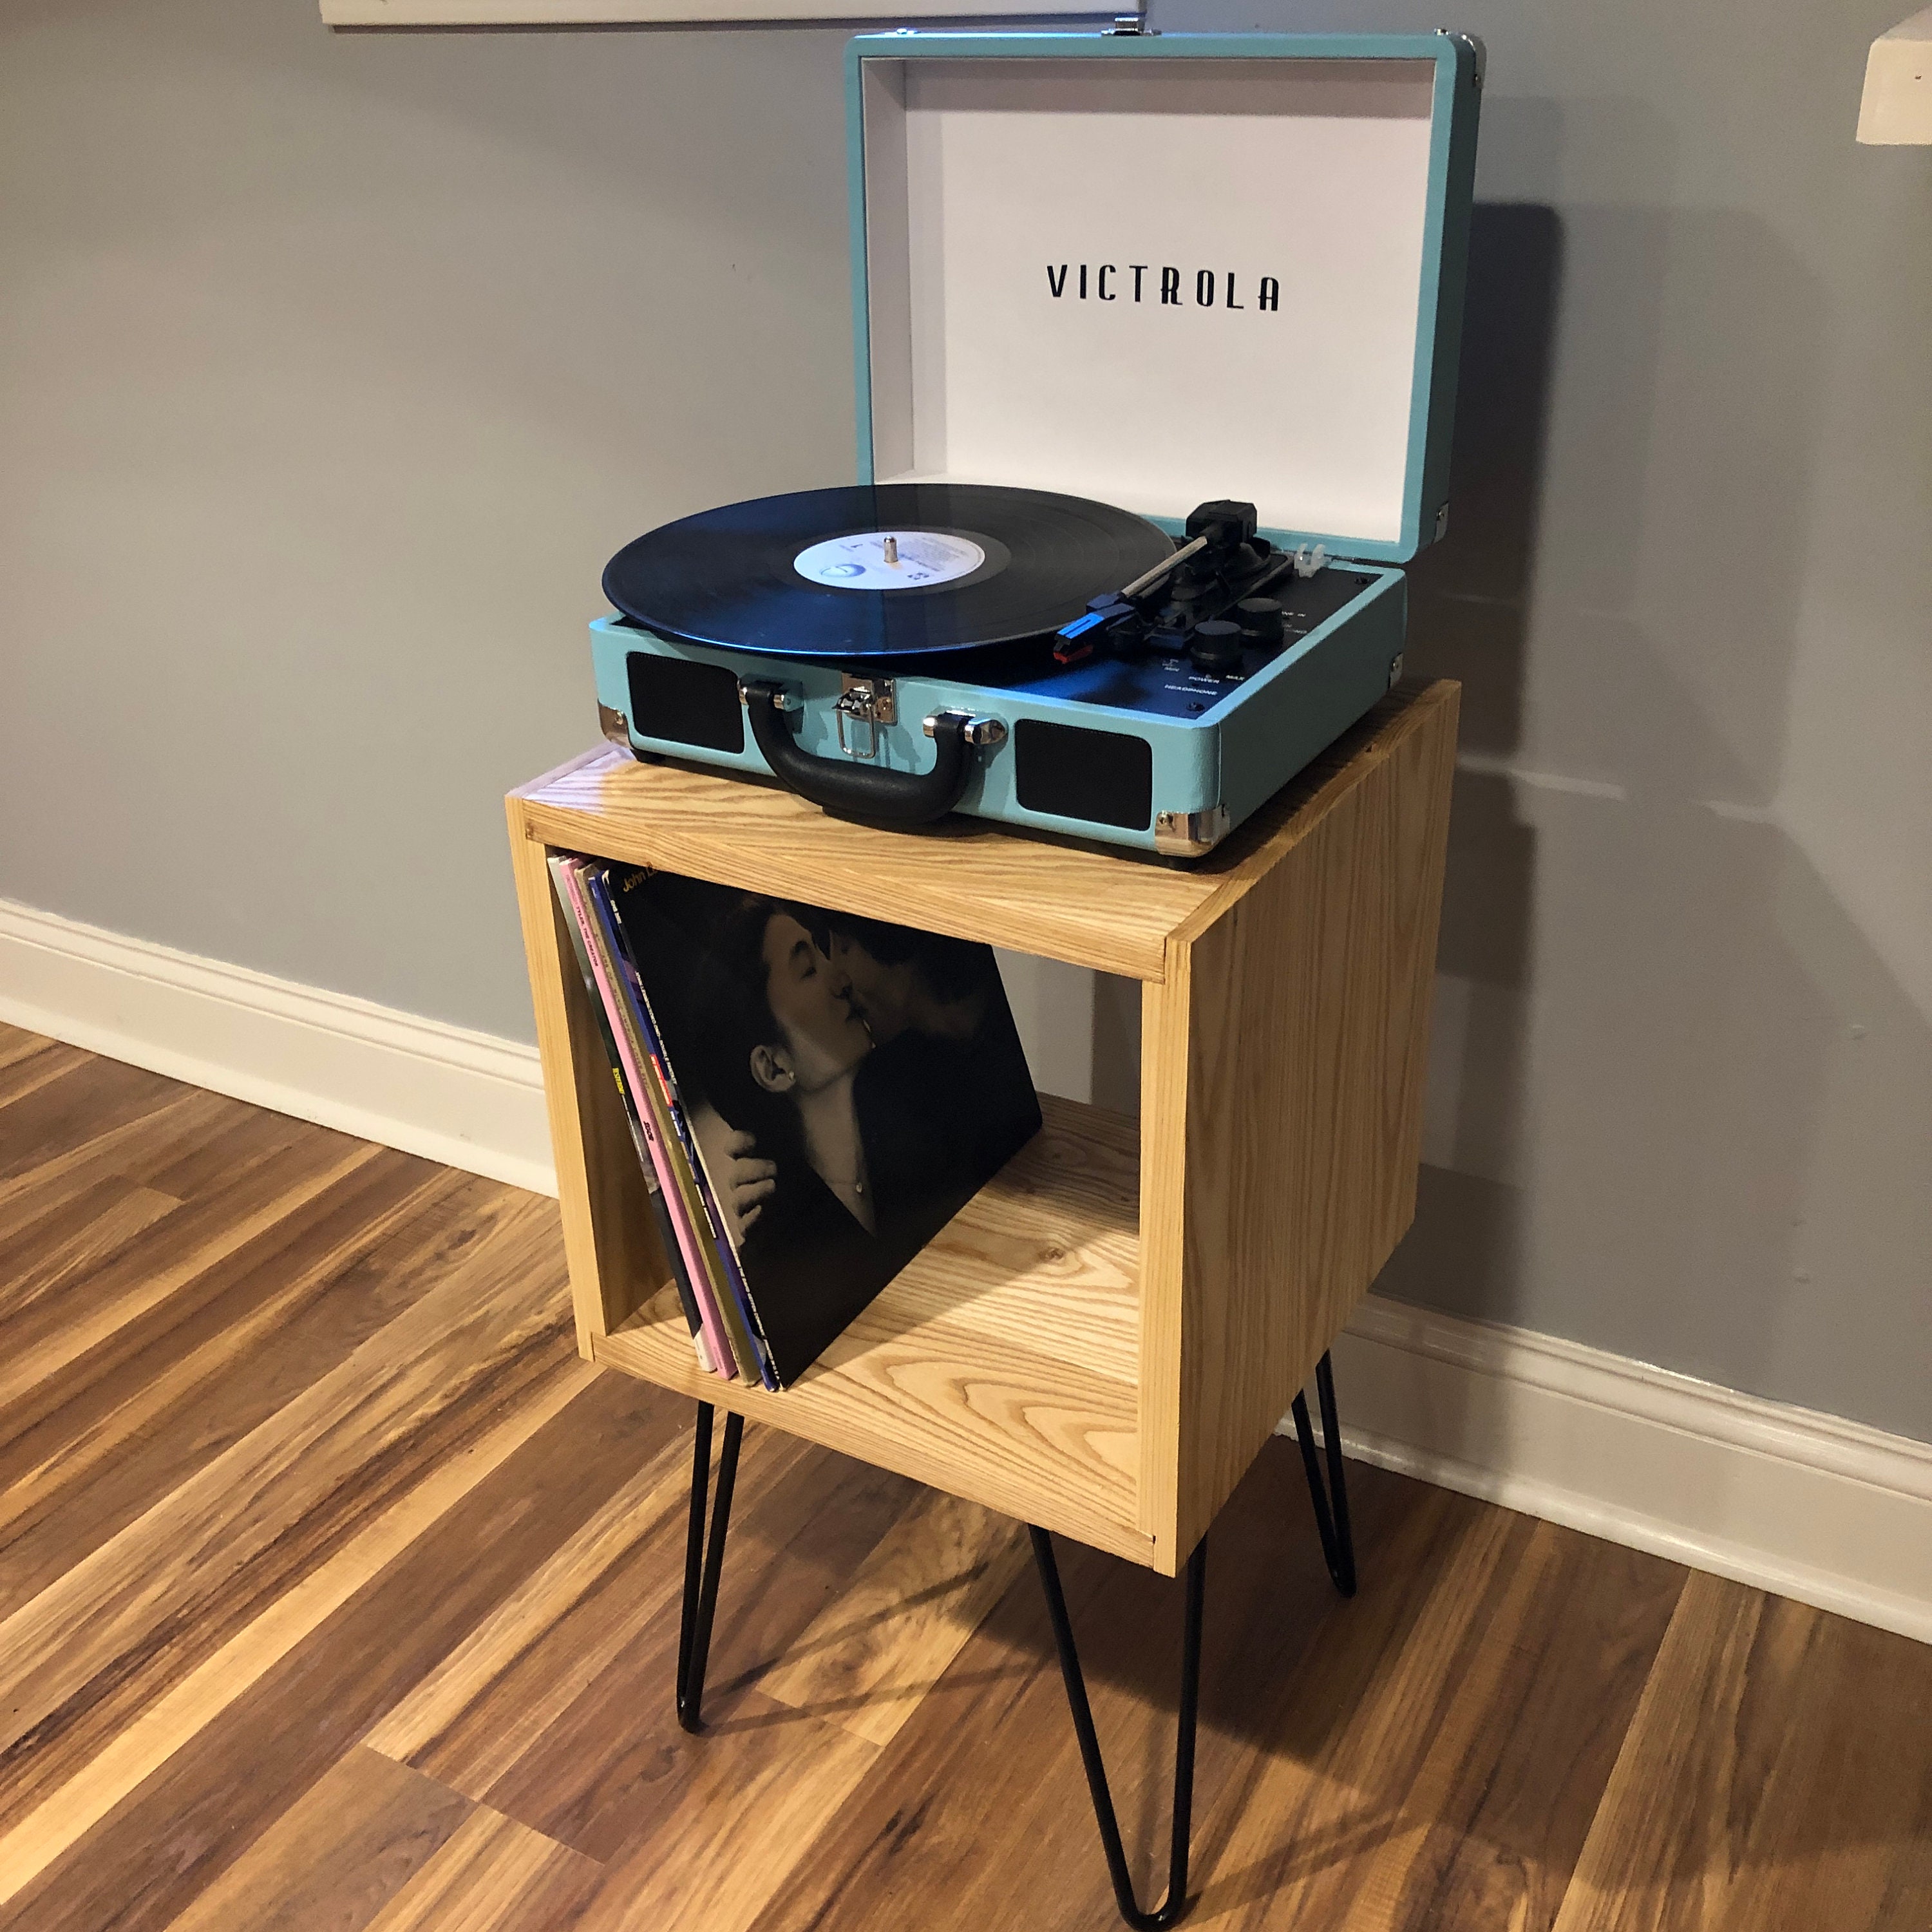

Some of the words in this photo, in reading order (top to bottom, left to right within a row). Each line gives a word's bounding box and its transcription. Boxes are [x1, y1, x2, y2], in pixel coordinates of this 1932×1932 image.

[1046, 264, 1279, 312] VICTROLA
[1164, 684, 1218, 696] HEADPHONE
[623, 871, 647, 893] John
[587, 940, 599, 967] CREATOR
